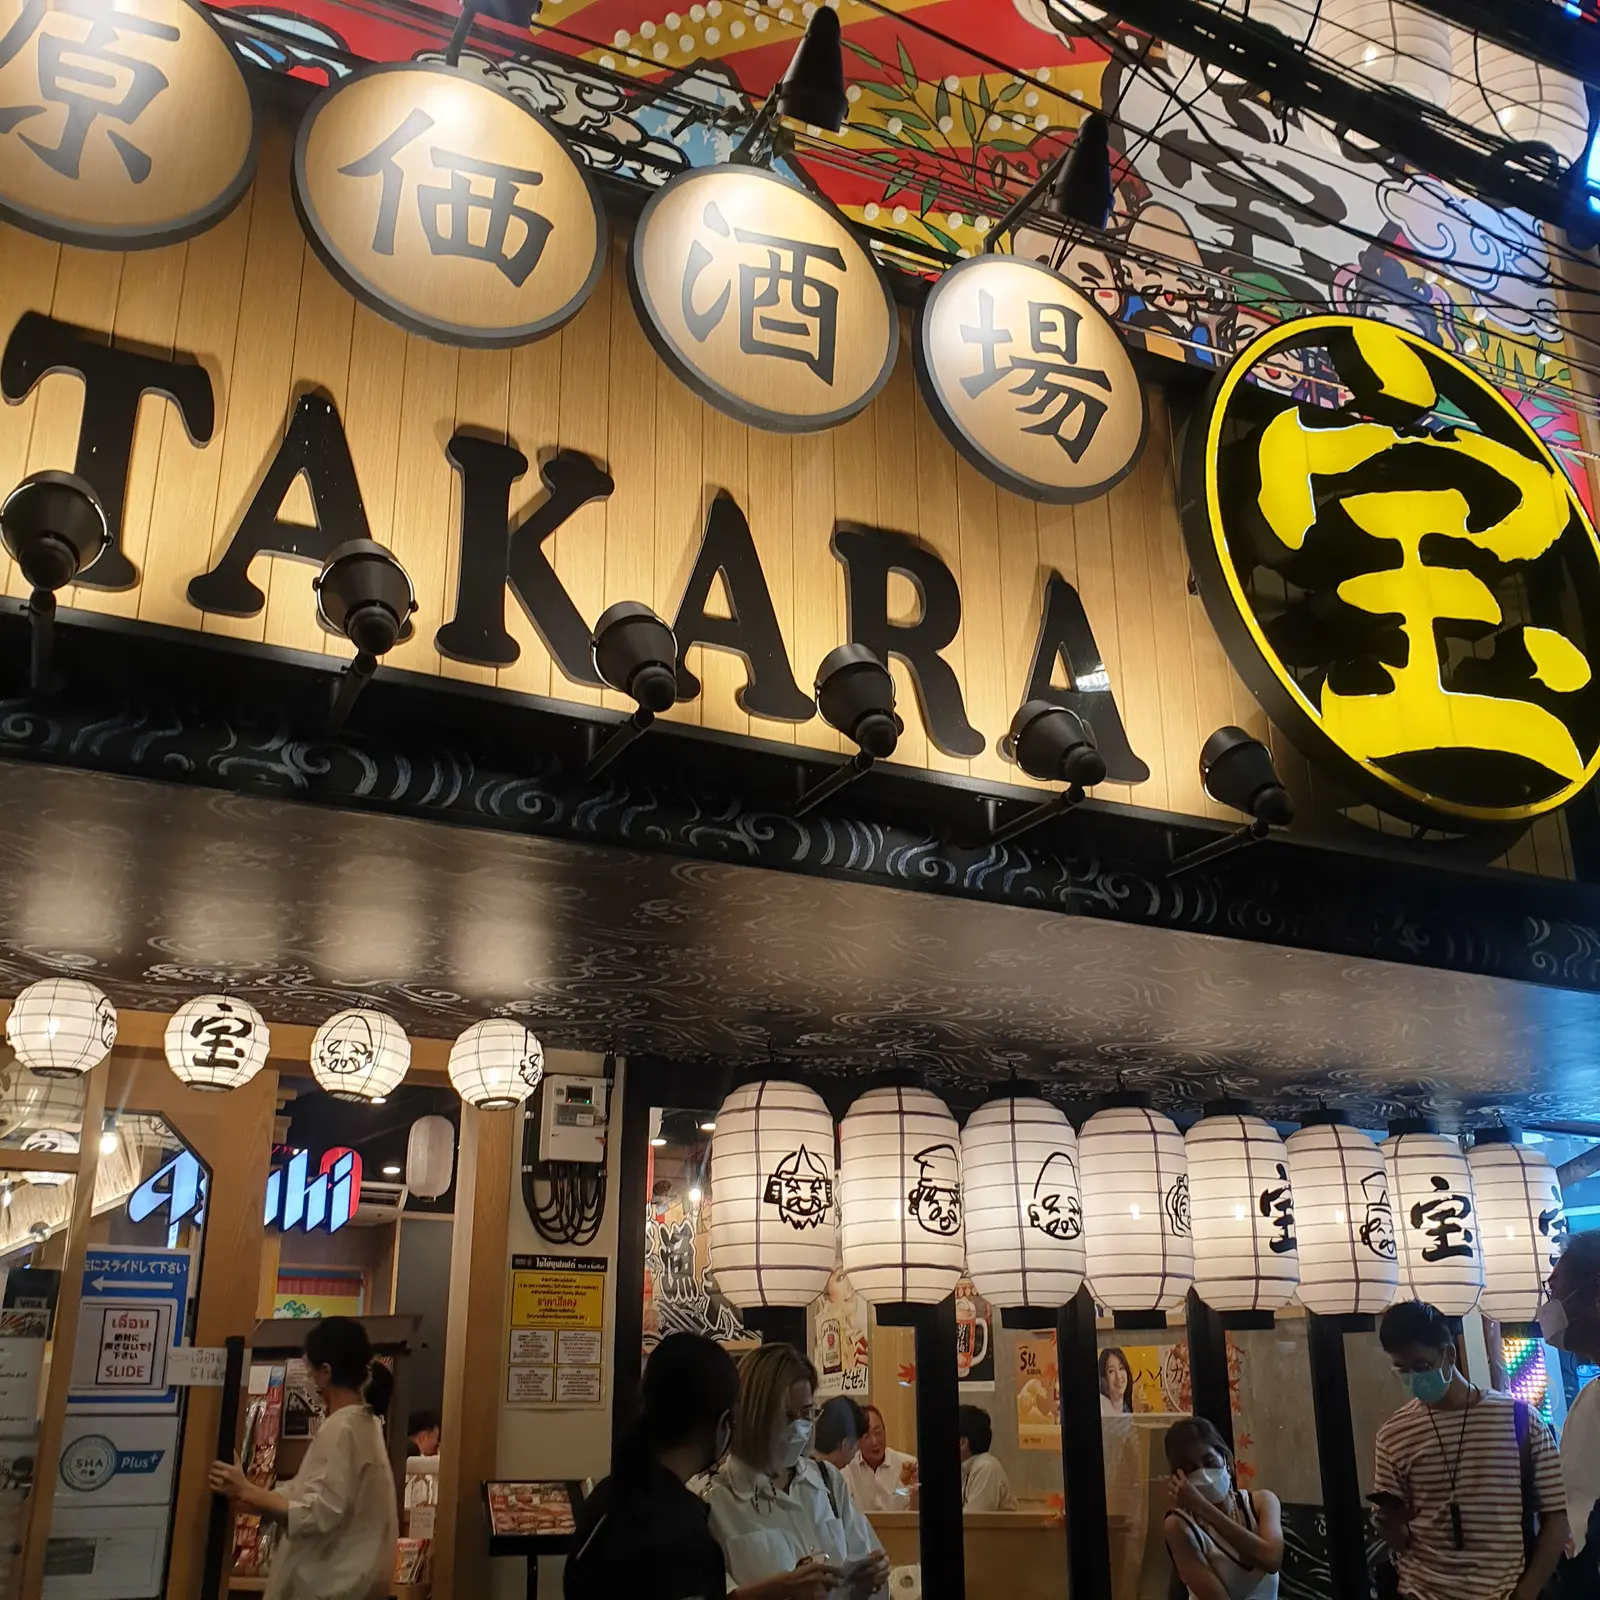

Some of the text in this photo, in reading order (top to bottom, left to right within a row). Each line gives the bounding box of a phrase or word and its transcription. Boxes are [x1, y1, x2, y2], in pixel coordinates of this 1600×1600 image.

[0, 0, 1112, 465] 原価酒場
[2, 311, 1150, 784] TAKARA
[1258, 325, 1591, 784] 宝
[190, 1003, 252, 1070] 宝
[127, 1149, 353, 1234] Ahi
[1410, 1176, 1474, 1262] 宝
[104, 1365, 145, 1378] SLIDE
[76, 1458, 103, 1469] SHA
